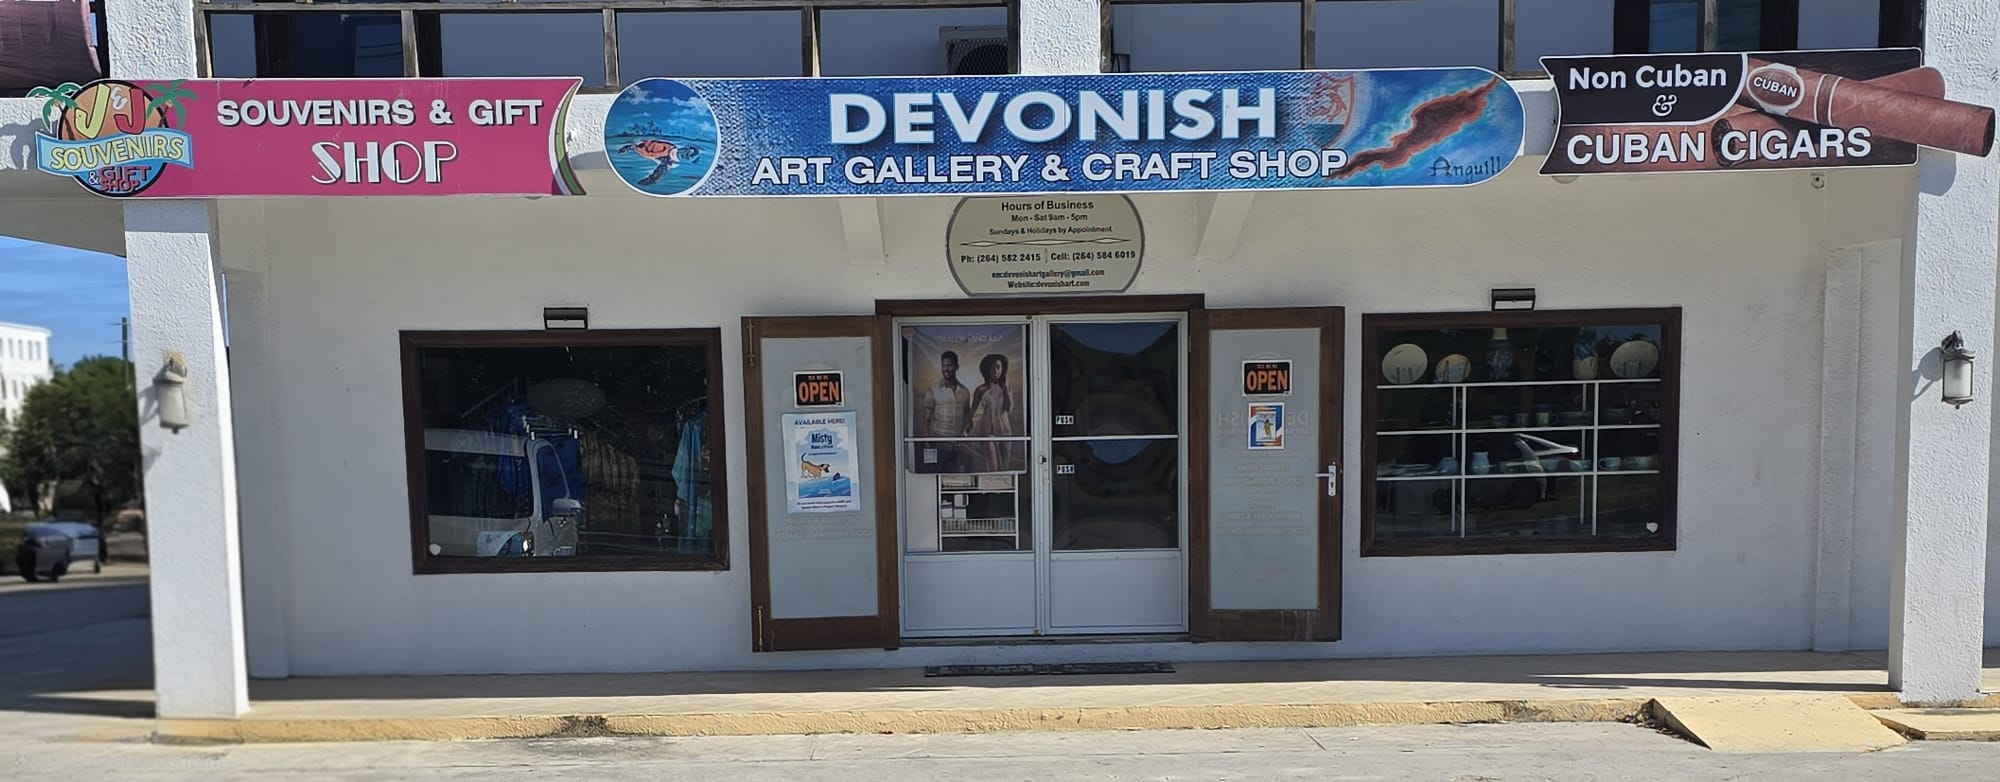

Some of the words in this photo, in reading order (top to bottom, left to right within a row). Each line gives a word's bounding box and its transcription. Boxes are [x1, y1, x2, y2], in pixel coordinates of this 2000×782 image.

[1569, 67, 1626, 90] Non
[1635, 65, 1727, 88] Cuban
[1753, 76, 1798, 98] CUBAN
[217, 99, 415, 126] SOUVENIRS
[428, 100, 454, 125] &
[468, 99, 543, 125] GIFT
[829, 88, 1277, 144] DEVONISH
[1652, 95, 1677, 117] &
[51, 135, 185, 170] SOUVENIRS
[1566, 132, 1706, 166] CUBAN
[1720, 126, 1872, 162] CIGARS
[311, 141, 458, 184] SHOP
[751, 157, 832, 185] ART
[844, 155, 1029, 184] GALLERY
[1040, 154, 1070, 182] &
[1082, 152, 1217, 182] CRAFT
[1228, 148, 1349, 180] SHOP
[1430, 156, 1509, 183] Anguill
[88, 172, 99, 185] &
[100, 166, 152, 182] GIFT
[101, 179, 141, 192] SHOP
[1001, 201, 1032, 211] Hours
[1034, 201, 1045, 210] of
[1046, 200, 1095, 210] Business
[1011, 214, 1029, 222] Mon
[1034, 214, 1048, 222] Sat
[1048, 213, 1065, 222] 9am
[1071, 213, 1088, 223] 5pm
[989, 227, 1019, 236] Sundays
[1027, 226, 1057, 236] Holidays
[1058, 226, 1067, 235] by
[1068, 225, 1112, 235] Appointment
[961, 255, 974, 263] Ph:
[976, 254, 999, 264] (264)
[1001, 254, 1017, 262] 582
[1019, 253, 1041, 262] 2415
[1050, 251, 1070, 261] Cell:
[1072, 251, 1095, 261] (264)
[1097, 251, 1112, 260] 584
[1115, 250, 1136, 260] 6019
[1246, 370, 1288, 391] OPEN
[799, 381, 840, 402] OPEN
[794, 418, 826, 426] AVAILABLE
[811, 433, 833, 446] Misty
